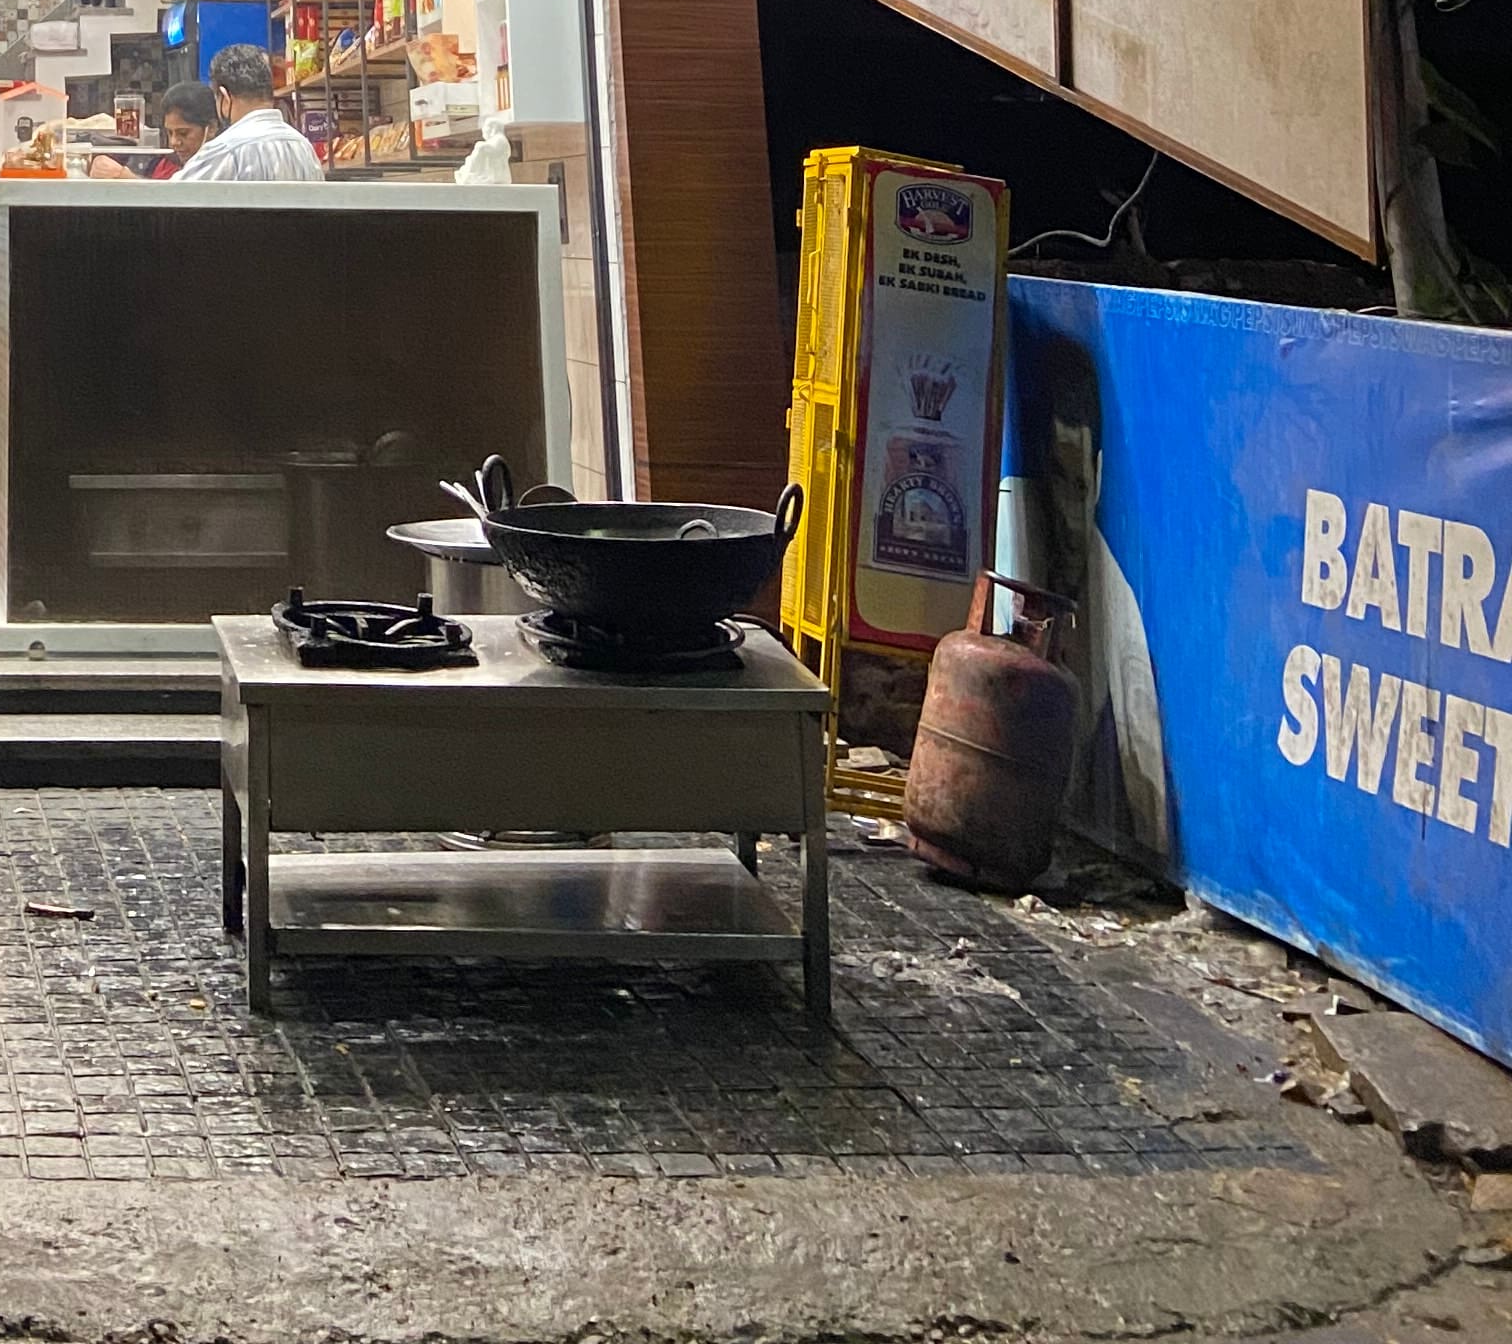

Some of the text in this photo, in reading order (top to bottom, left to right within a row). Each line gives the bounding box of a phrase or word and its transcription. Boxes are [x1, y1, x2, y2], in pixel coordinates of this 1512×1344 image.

[903, 247, 920, 261] EK
[899, 262, 916, 276] EK
[878, 274, 895, 288] EK
